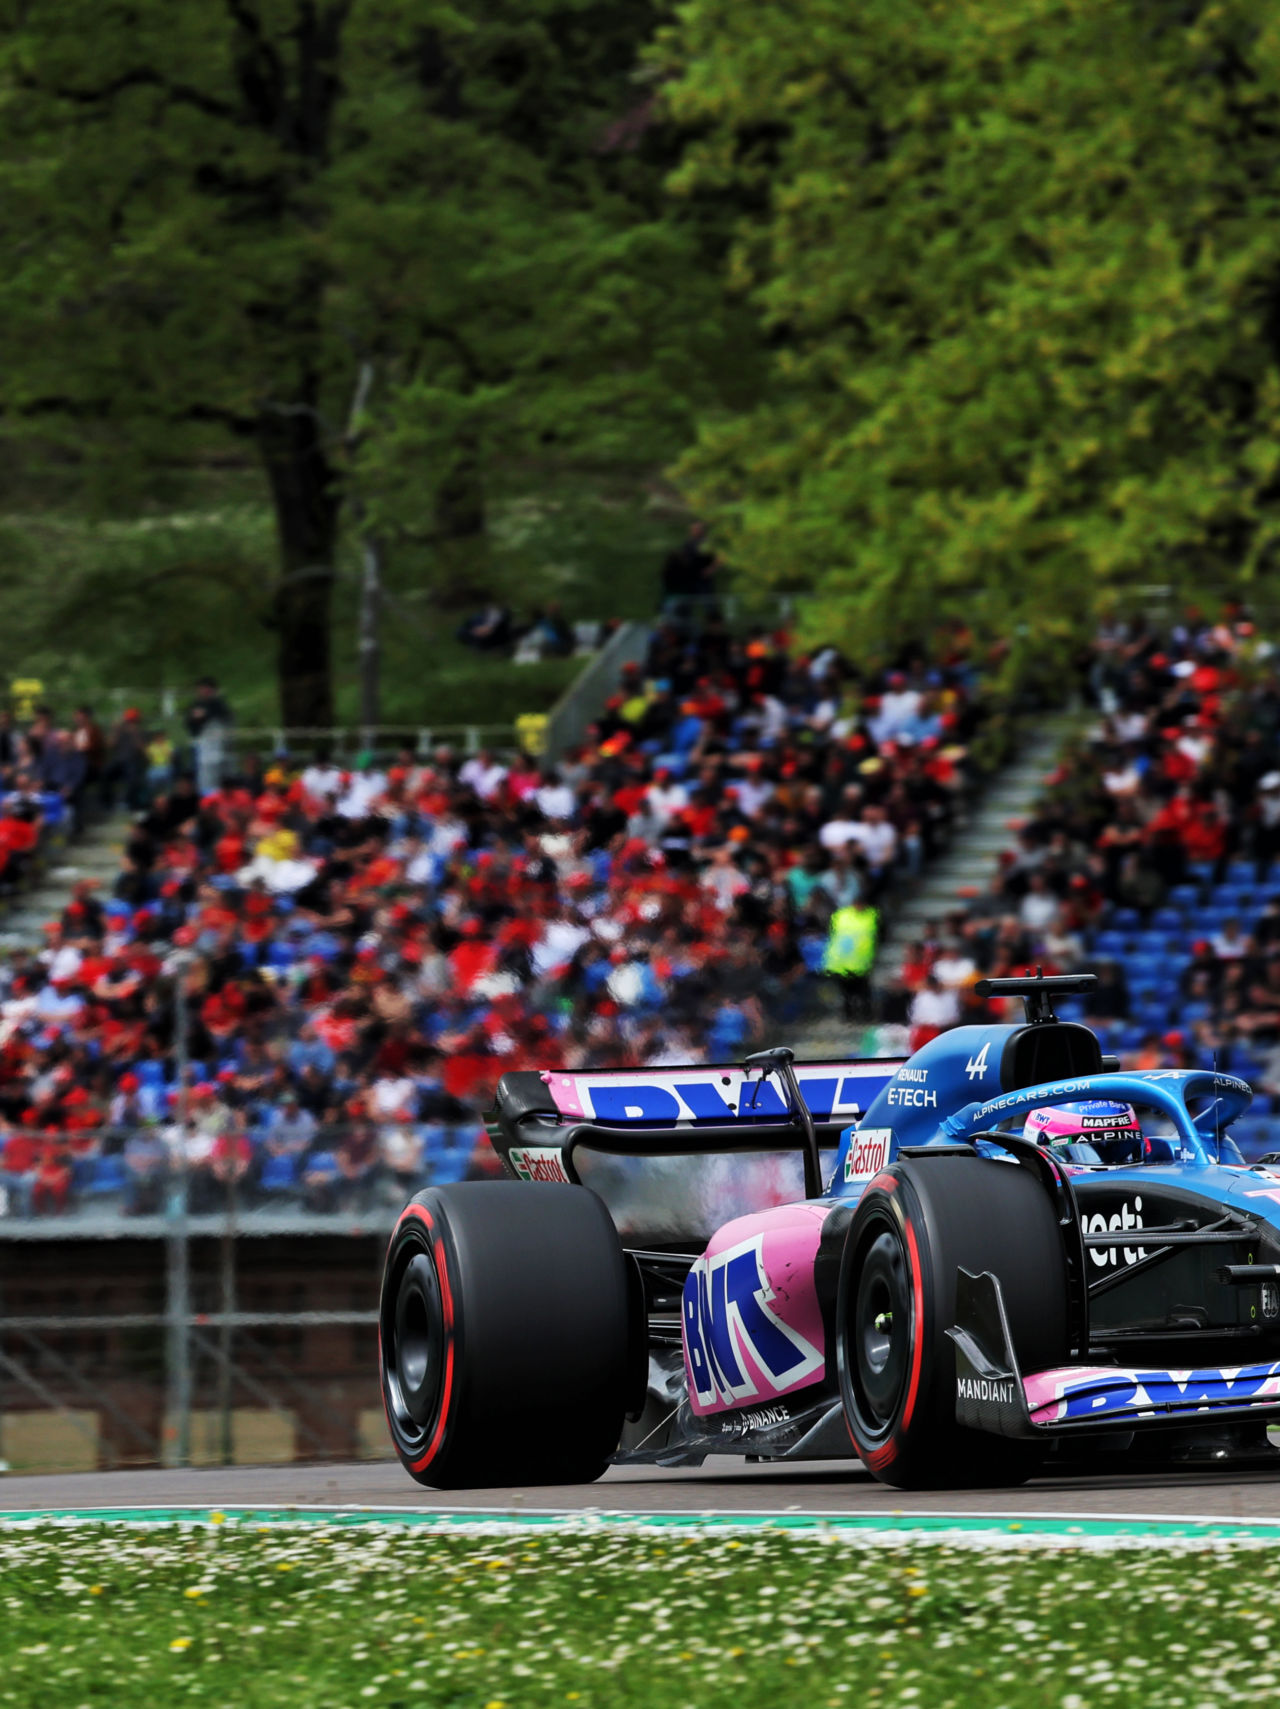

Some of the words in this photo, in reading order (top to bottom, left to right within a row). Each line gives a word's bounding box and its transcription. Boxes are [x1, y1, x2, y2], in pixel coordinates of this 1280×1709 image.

[898, 1068, 928, 1083] RENAULT
[973, 1081, 1091, 1122] ALPINECARS.COM
[1078, 1099, 1107, 1112] Private
[1034, 1112, 1051, 1125] BWT
[1082, 1114, 1131, 1128] MAPFRE
[1075, 1131, 1141, 1144] ALPINE
[522, 1152, 568, 1184] Castrol
[850, 1136, 887, 1176] Castrol
[682, 1240, 817, 1402] BWT
[957, 1377, 1014, 1403] MANDIANT
[748, 1405, 791, 1431] BINANCE
